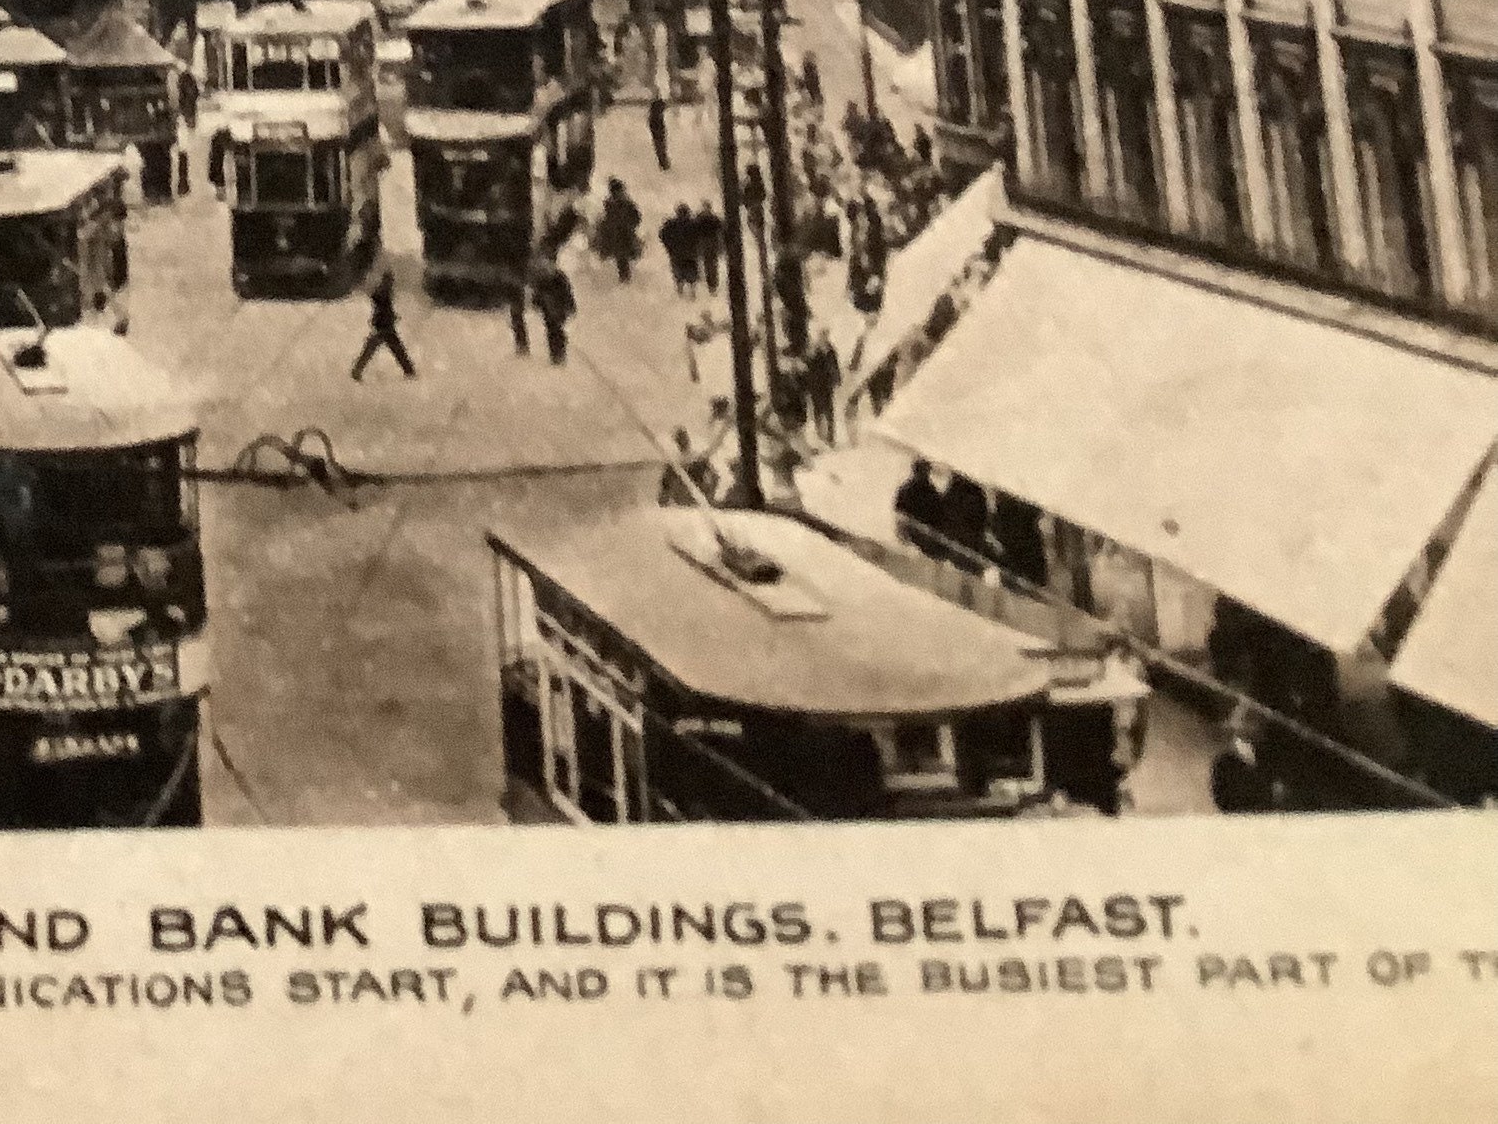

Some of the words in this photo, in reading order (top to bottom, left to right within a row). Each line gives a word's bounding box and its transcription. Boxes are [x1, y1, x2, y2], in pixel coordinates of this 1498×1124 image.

[148, 901, 371, 955] BANK
[419, 900, 840, 951] BUILDINGS.
[868, 892, 1199, 946] BELFAST.
[285, 966, 477, 1017] START,
[499, 966, 611, 1004] AND
[635, 965, 679, 1001] IT
[703, 963, 757, 1003] IS
[783, 960, 890, 1000] THE
[919, 955, 1163, 996] BUSIEST
[1195, 951, 1339, 990] PART
[1365, 948, 1432, 989] OF
